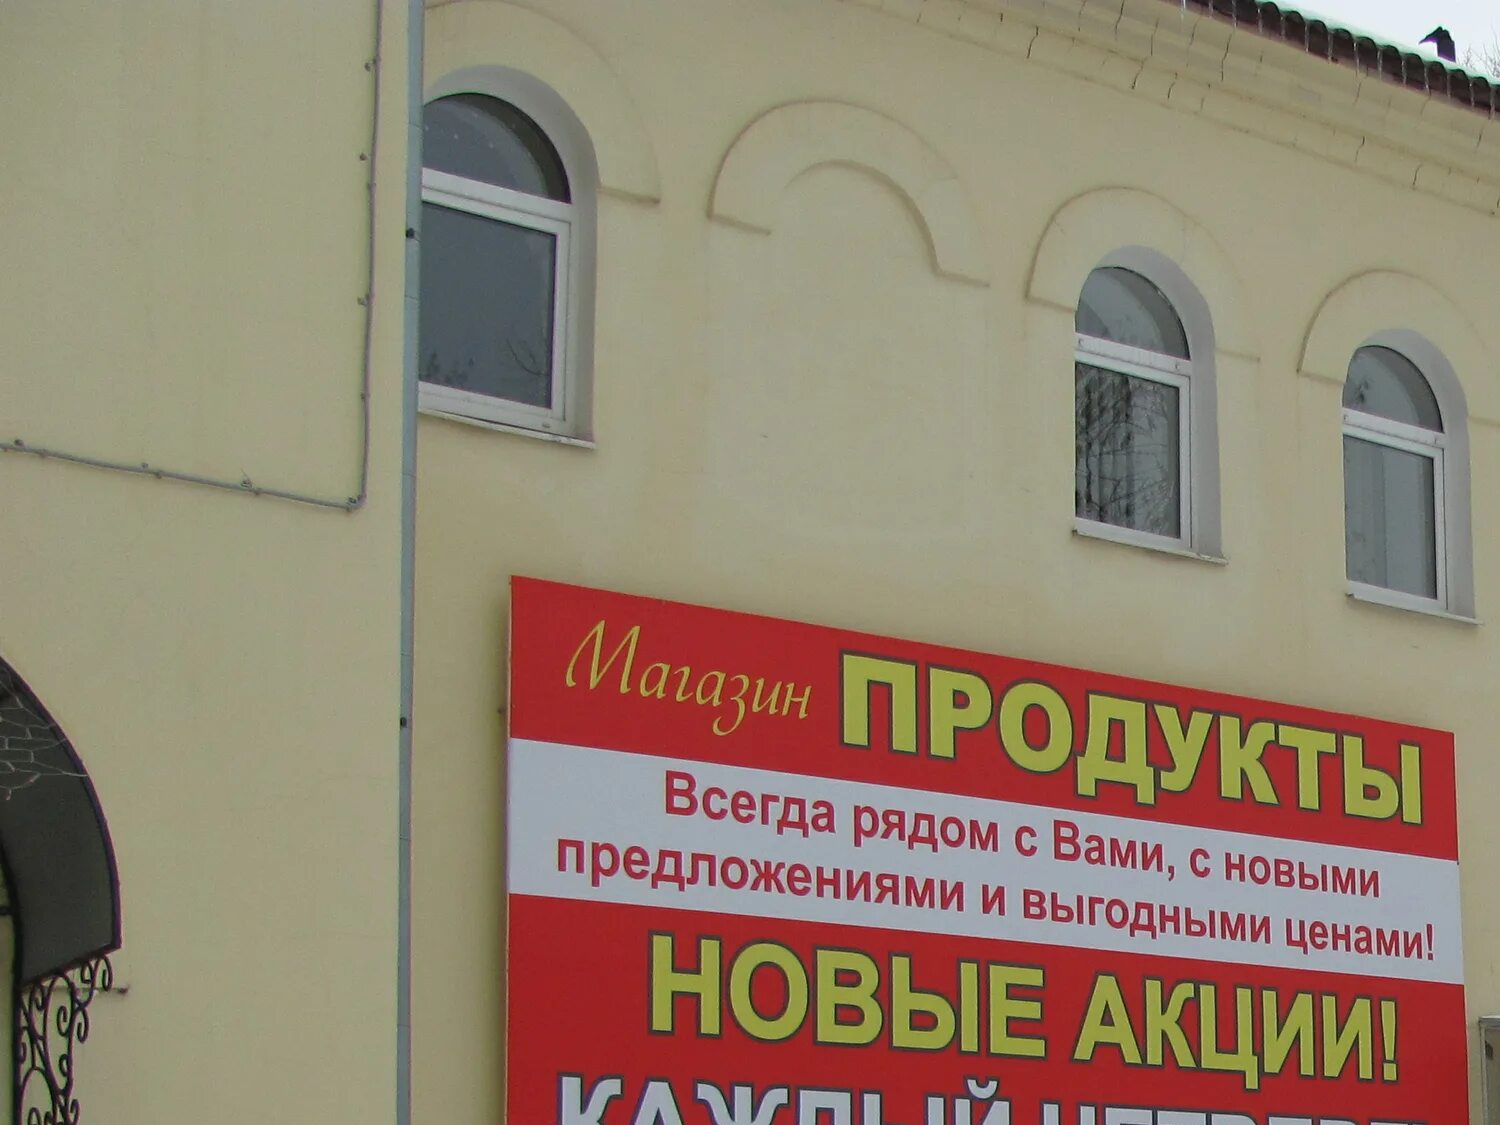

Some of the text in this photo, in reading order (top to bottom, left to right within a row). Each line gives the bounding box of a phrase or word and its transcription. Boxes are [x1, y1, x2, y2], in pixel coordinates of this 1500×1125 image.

[565, 619, 1425, 826] Магазин ПРОДУКТЫ
[557, 833, 1434, 961] предложениями и выгодными ценами!
[665, 770, 1380, 898] Всегда рядом с Вами, с новыми
[652, 934, 1397, 1090] НОВЫЕ АКЦИИ!
